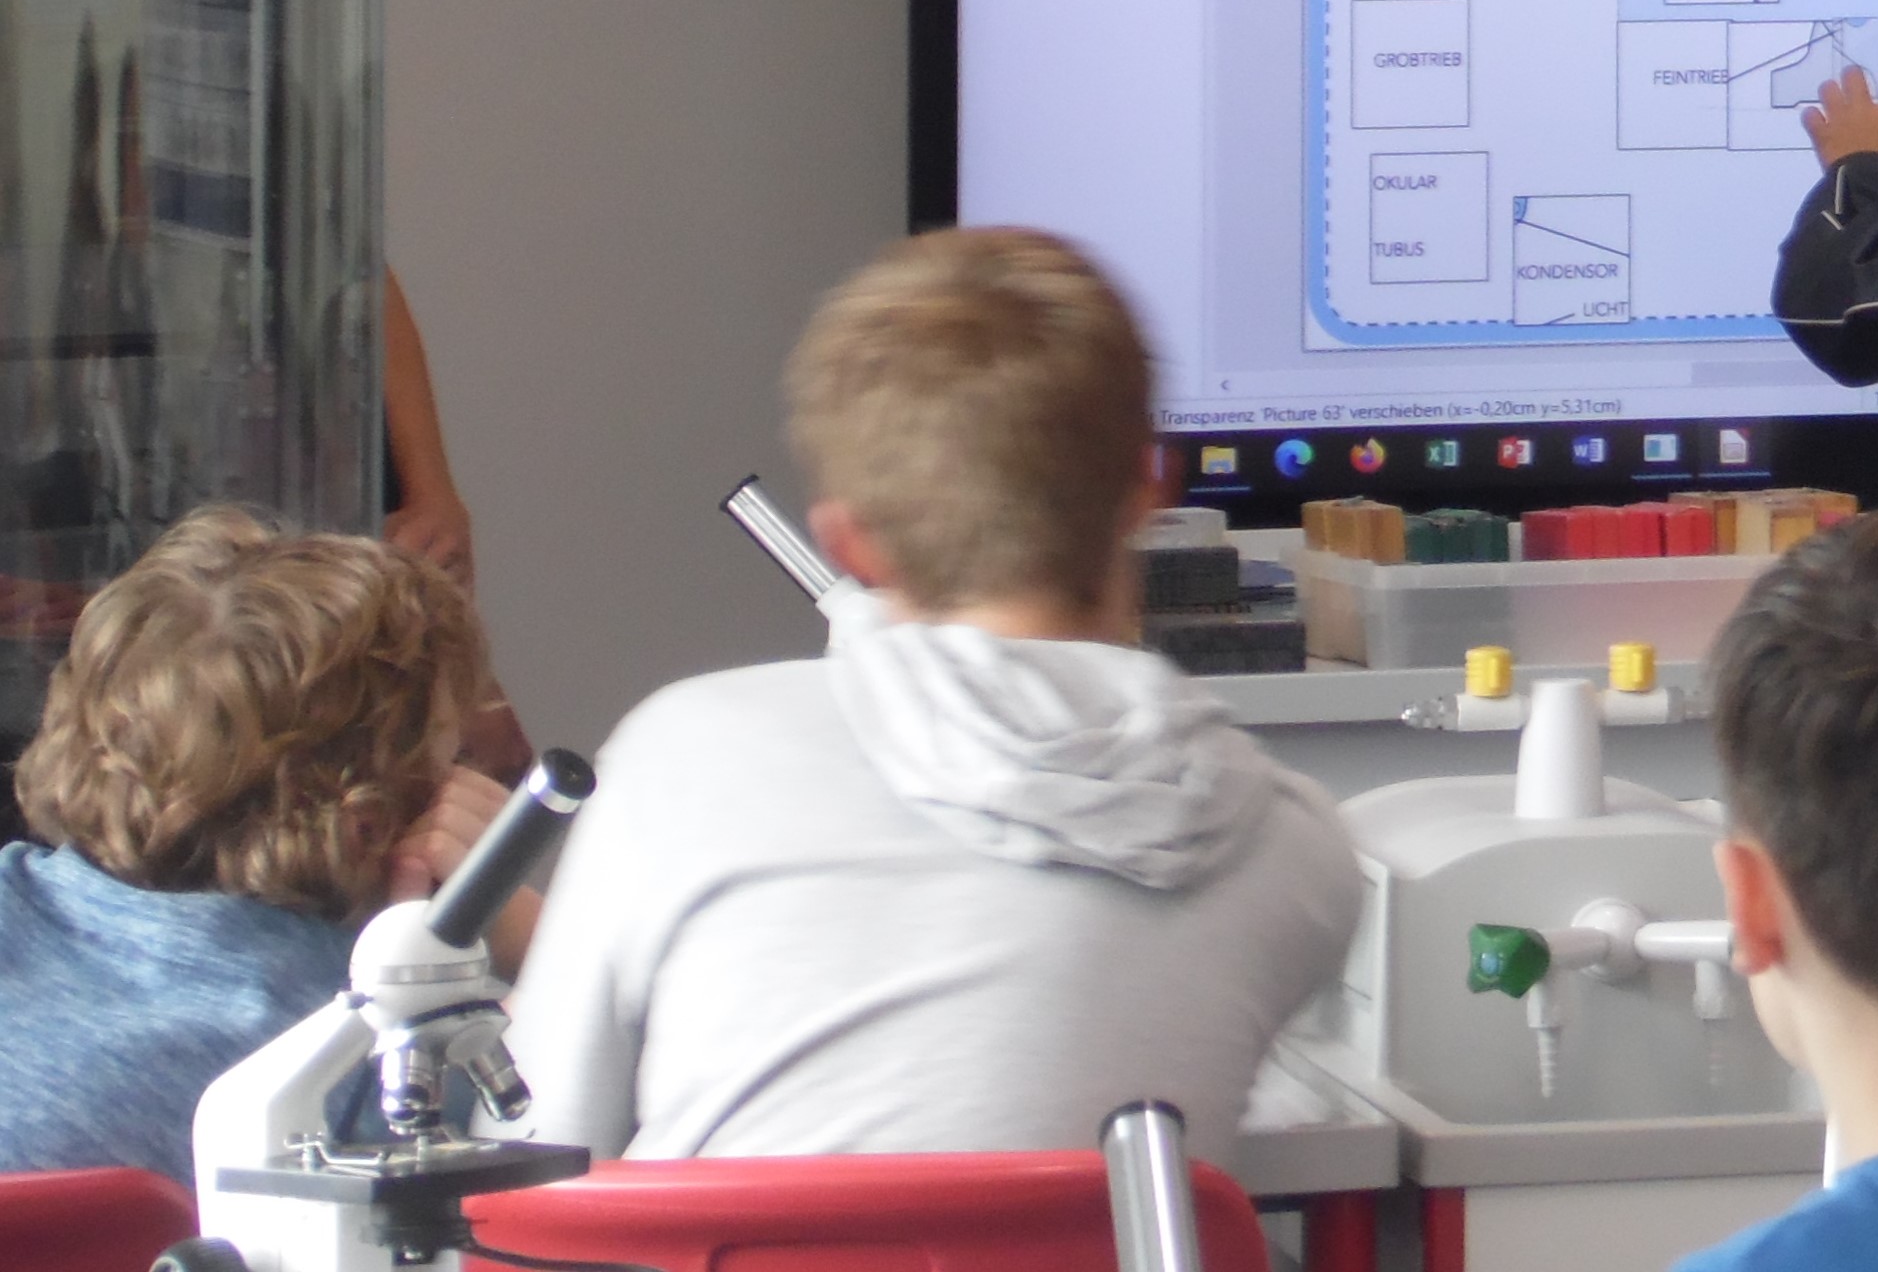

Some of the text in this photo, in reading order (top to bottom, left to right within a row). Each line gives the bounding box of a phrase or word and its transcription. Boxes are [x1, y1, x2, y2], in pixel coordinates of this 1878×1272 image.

[1373, 52, 1462, 69] GROBTRIEB
[1372, 175, 1438, 191] OKULAR
[1374, 242, 1425, 257] TUBUS
[1516, 263, 1618, 280] KONDENSOR
[1583, 302, 1629, 317] LICHT
[1161, 408, 1254, 425] Transparenz
[1350, 403, 1442, 419] verschieben
